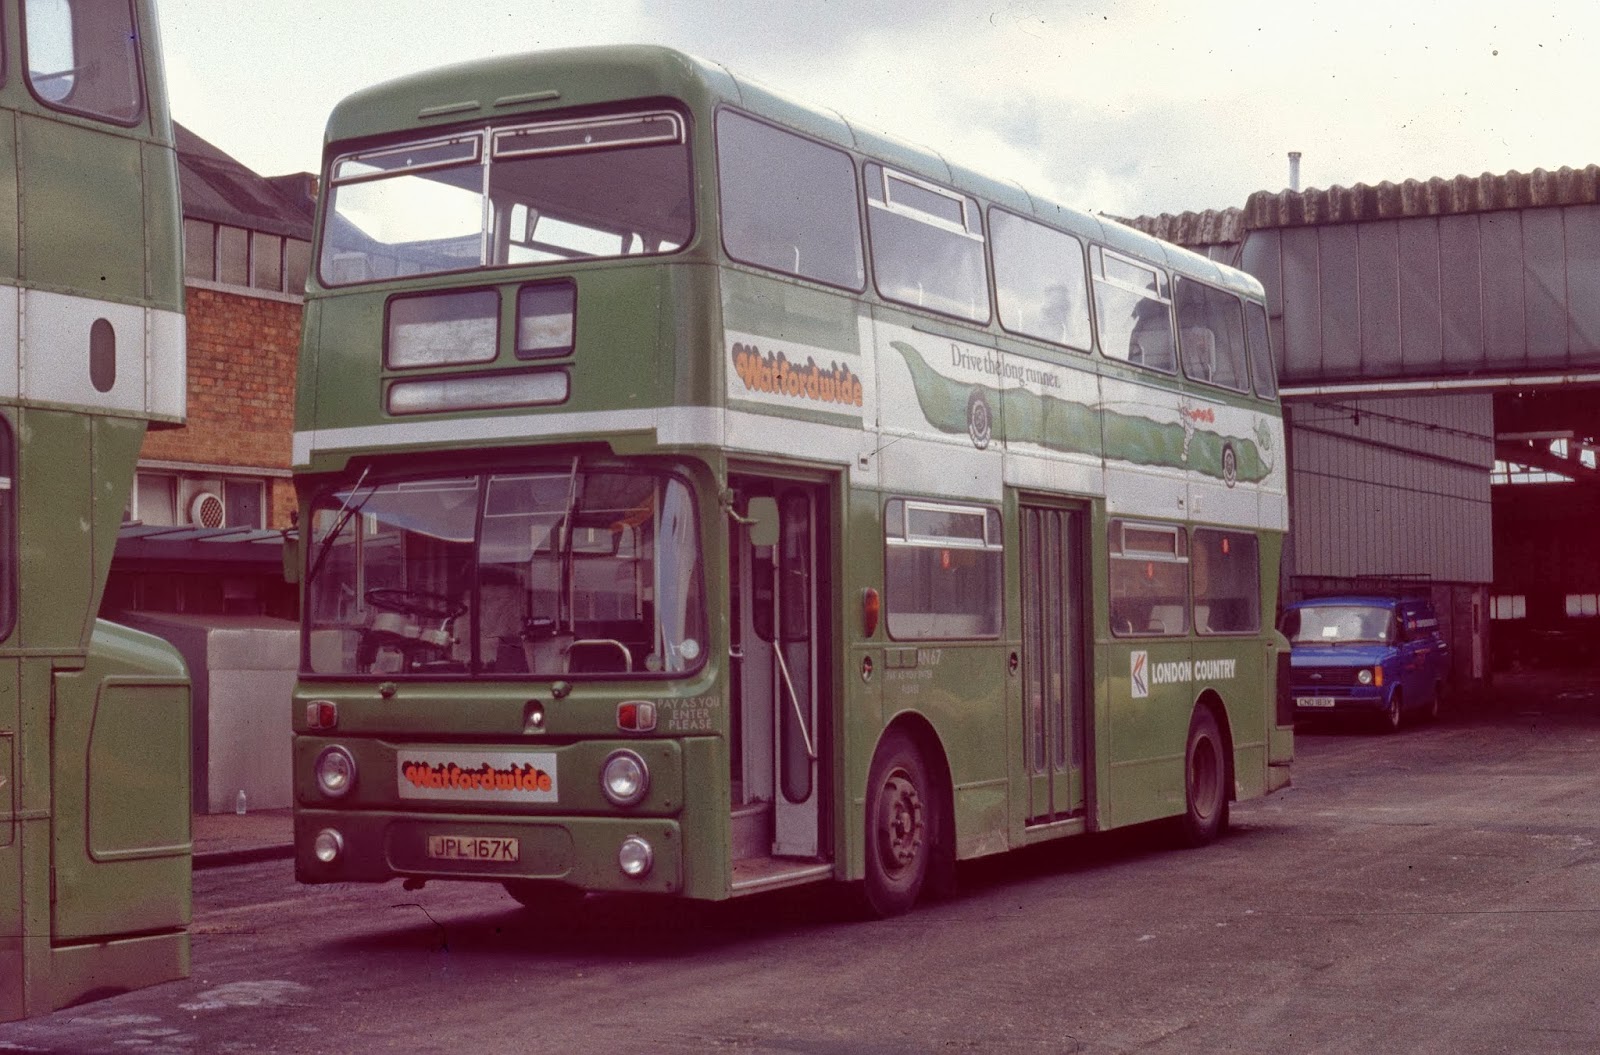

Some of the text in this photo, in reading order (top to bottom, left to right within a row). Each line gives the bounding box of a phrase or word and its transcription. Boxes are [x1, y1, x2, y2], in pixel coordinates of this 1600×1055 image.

[951, 343, 983, 372] Drive
[985, 350, 1002, 376] the
[1002, 353, 1026, 387] long
[1151, 658, 1236, 684] LONDON COUNTRY
[657, 696, 720, 709] PAY AS YOU
[668, 719, 712, 730] PLEASE
[672, 708, 709, 720] ENTER
[402, 760, 552, 792] Watfordwide
[434, 838, 513, 859] JPL 167K
